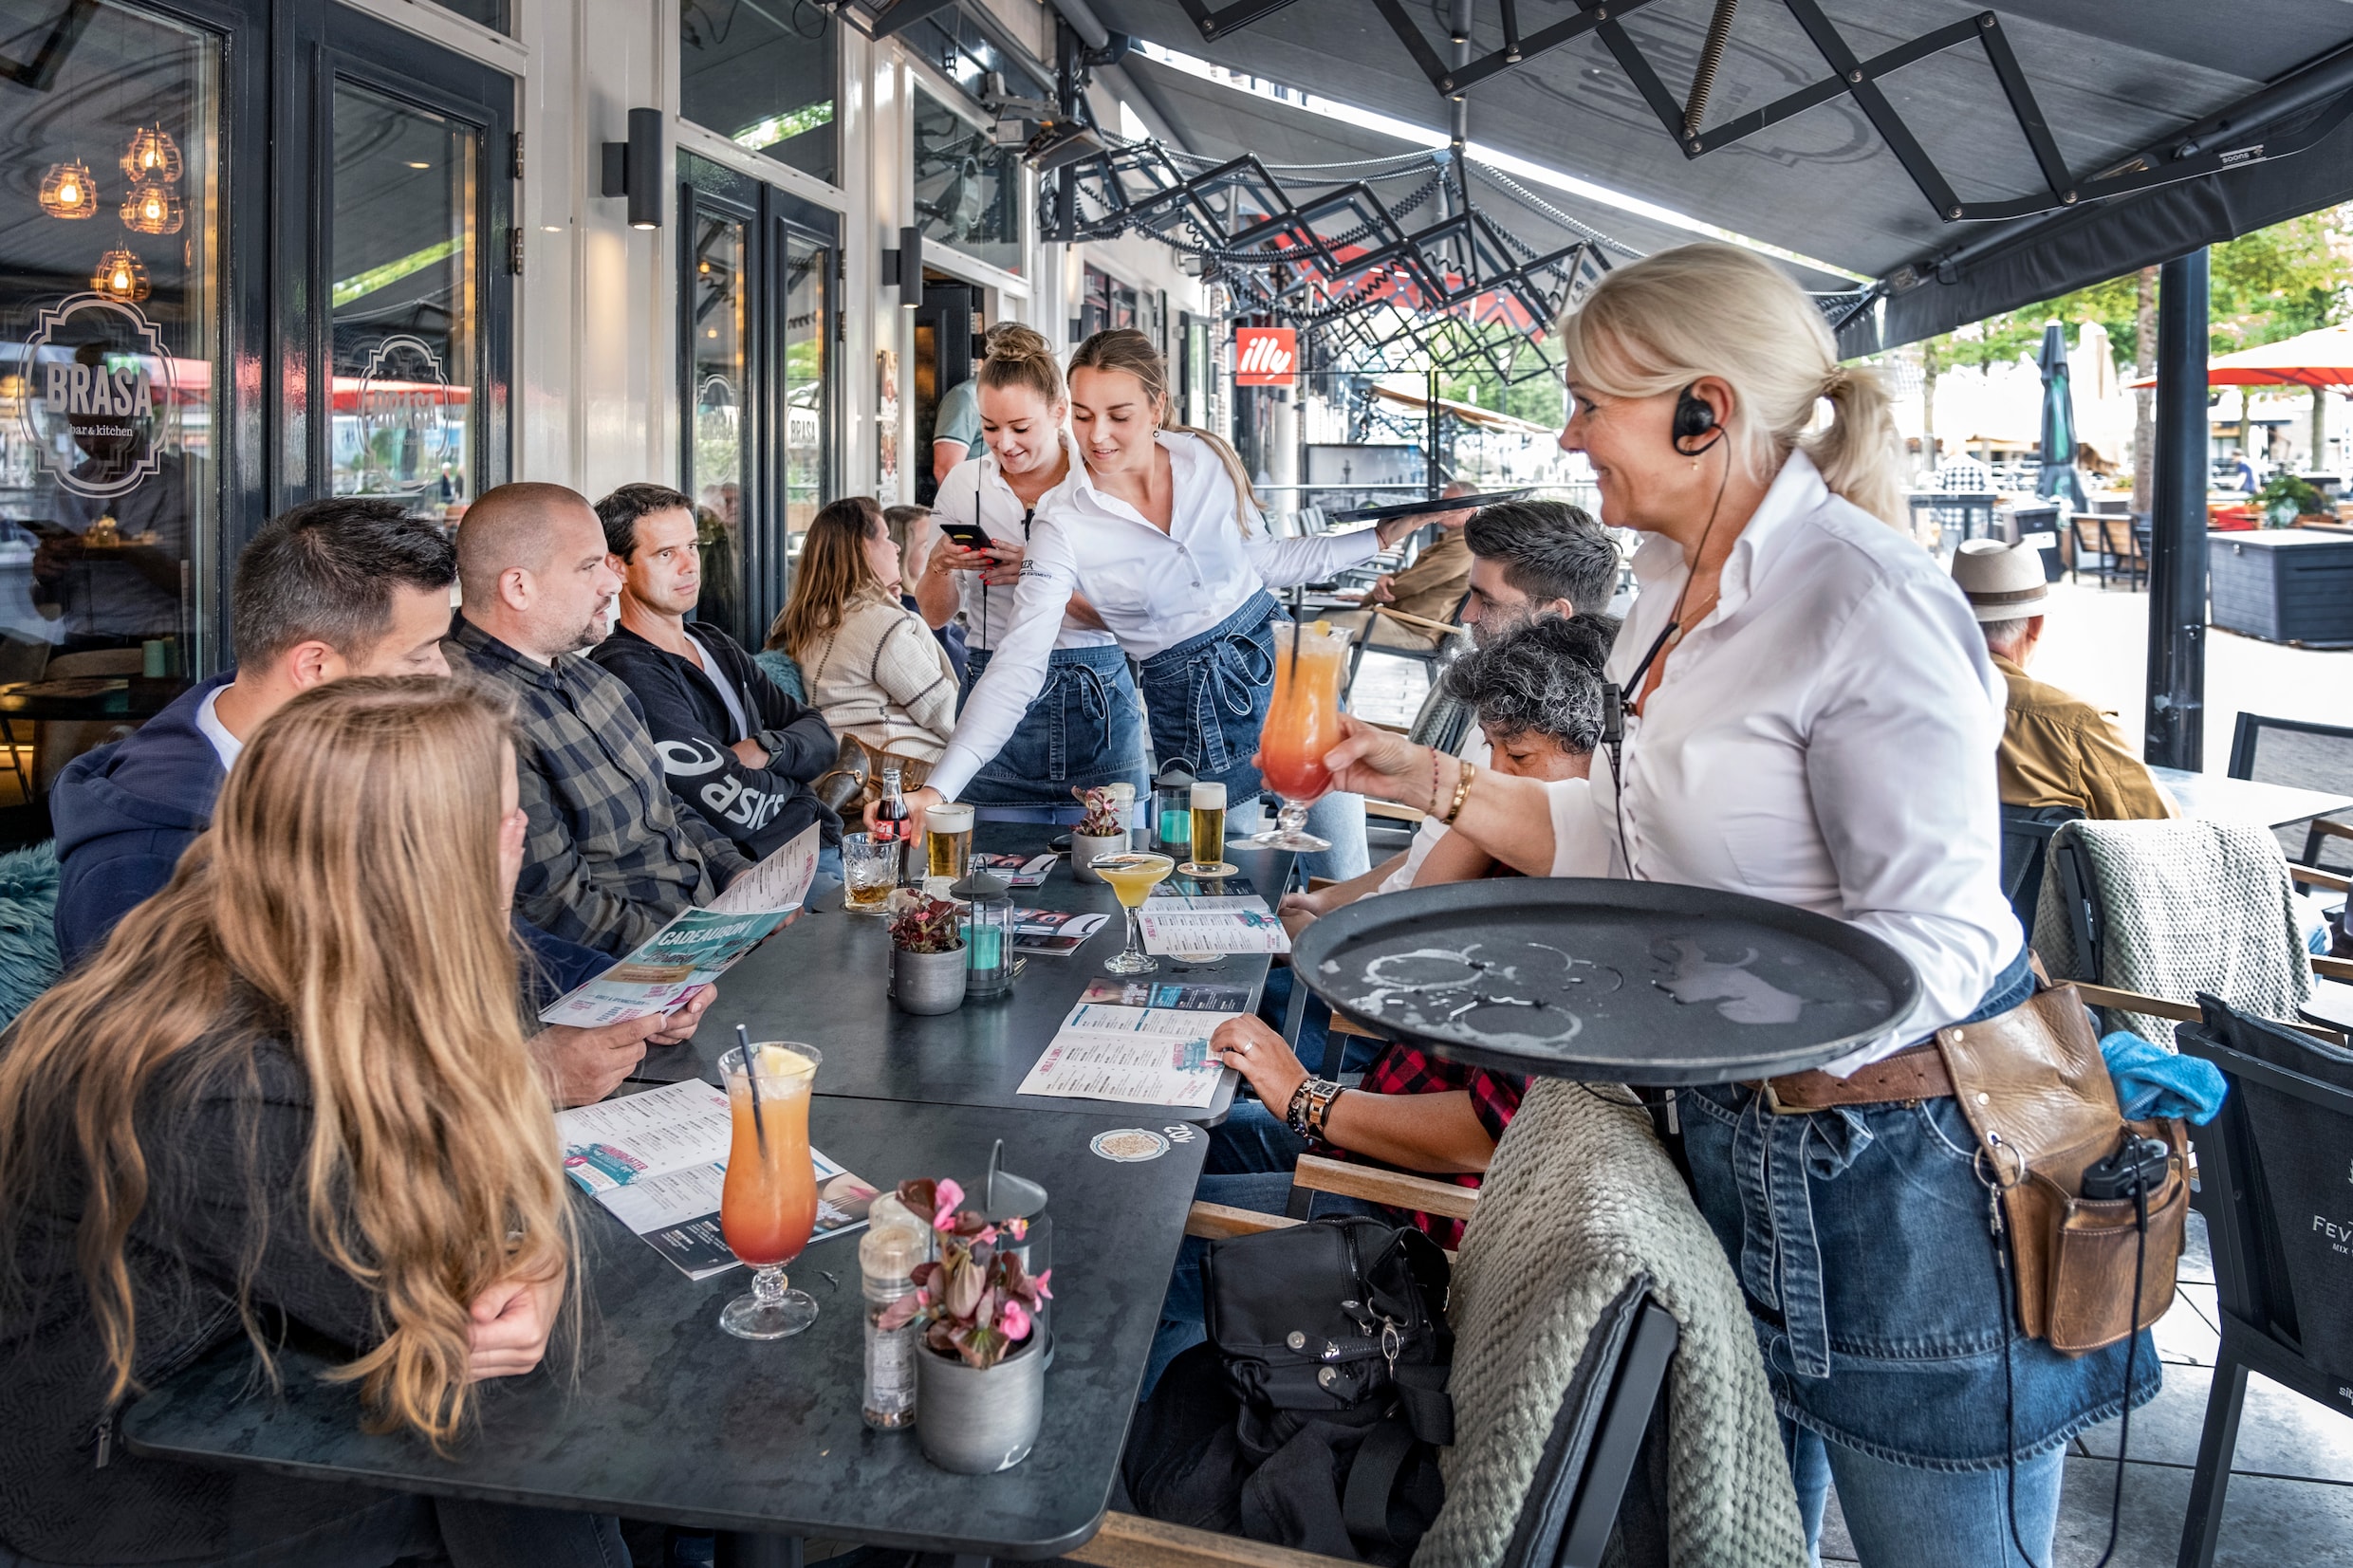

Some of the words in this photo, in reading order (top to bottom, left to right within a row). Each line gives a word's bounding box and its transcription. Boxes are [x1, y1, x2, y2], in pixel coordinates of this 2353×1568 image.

[2222, 152, 2250, 163] soons
[1240, 336, 1291, 380] illy
[46, 361, 153, 417] BRASA
[373, 389, 437, 430] BRASA
[69, 424, 87, 435] bar
[88, 426, 95, 435] &
[97, 425, 133, 436] kitchen
[790, 419, 816, 444] BRASA
[700, 773, 786, 831] asics
[658, 919, 752, 947] CADEAUBON
[1163, 1124, 1196, 1143] 102
[2312, 1214, 2353, 1245] FEV
[2332, 1243, 2348, 1254] MIX
[2339, 1386, 2353, 1406] sit
